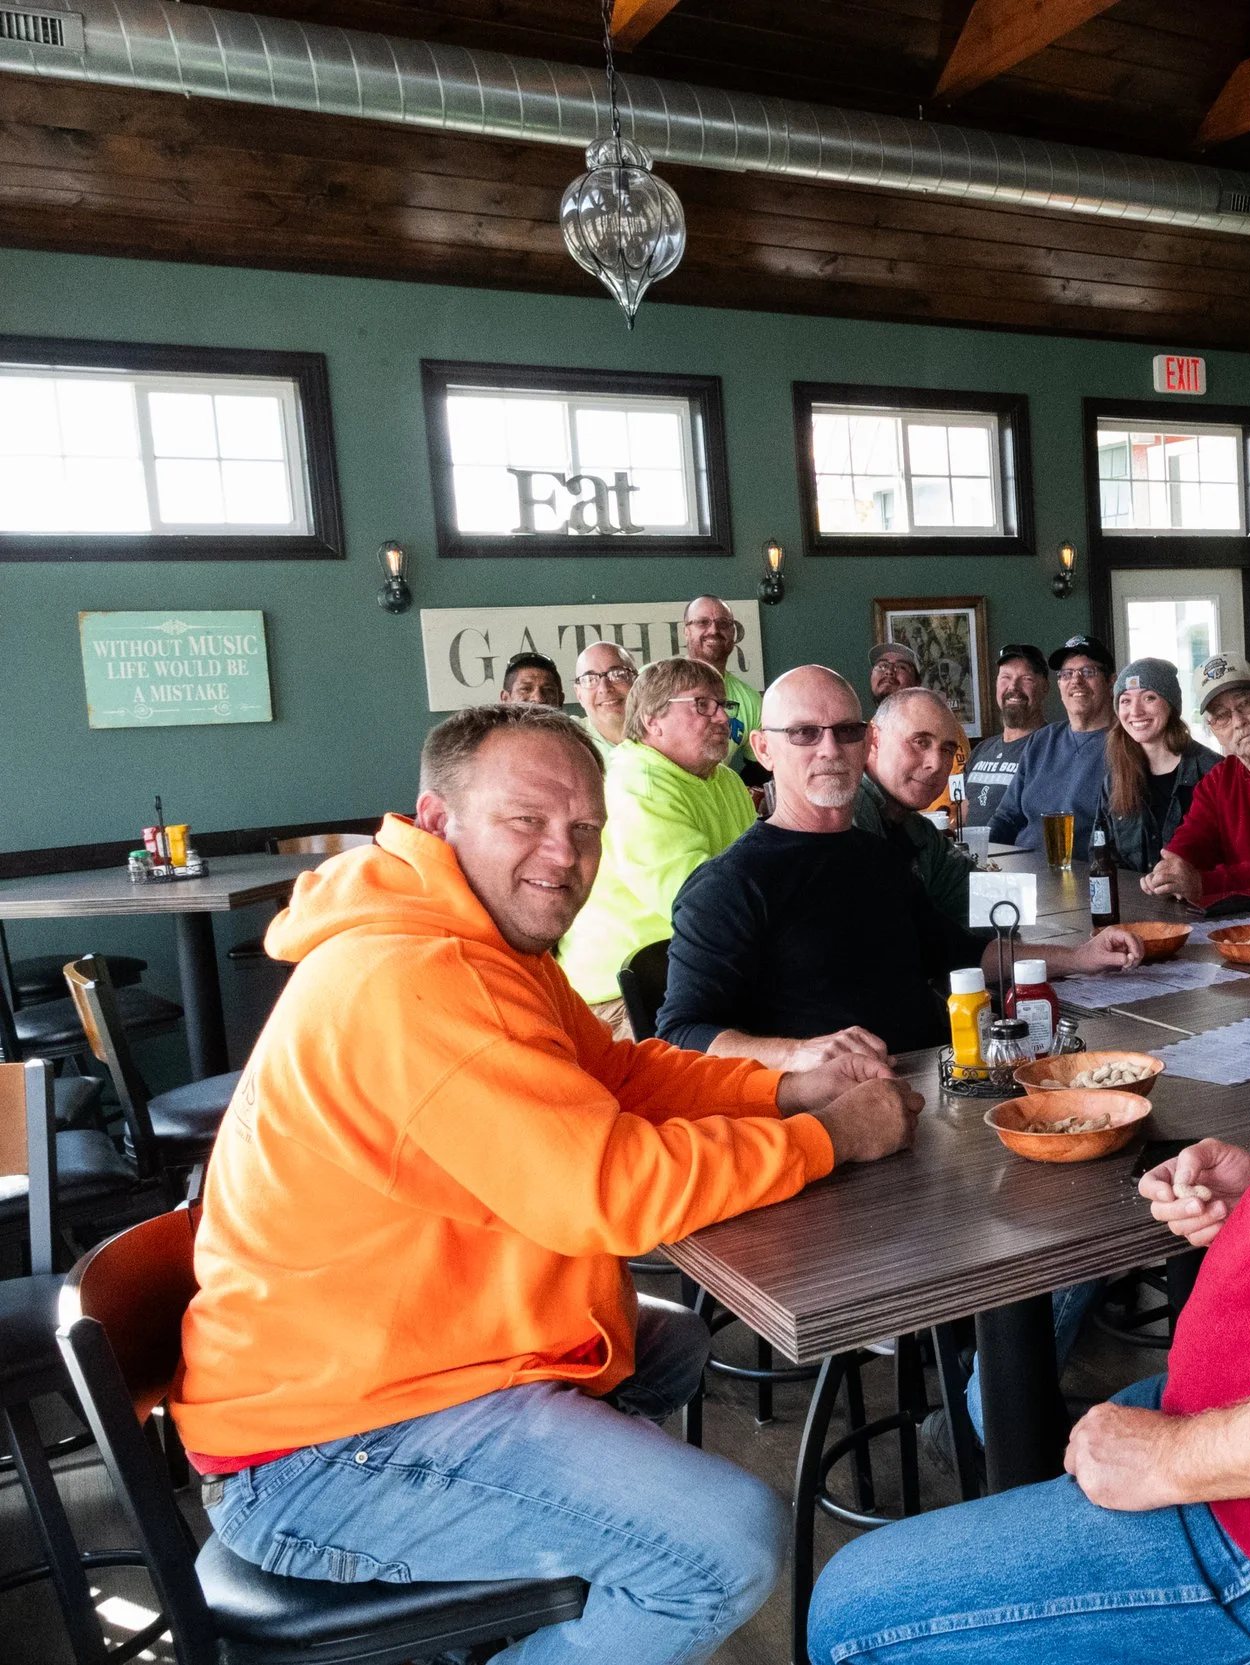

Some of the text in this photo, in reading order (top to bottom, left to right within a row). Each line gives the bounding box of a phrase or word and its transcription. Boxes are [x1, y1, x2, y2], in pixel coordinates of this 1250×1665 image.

[1166, 357, 1200, 391] EXIT
[507, 467, 645, 535] Eat
[93, 635, 258, 658] WITHOUT MUSIC
[107, 659, 249, 680] LIFE WOULD BE
[133, 683, 230, 702] A MISTAKE
